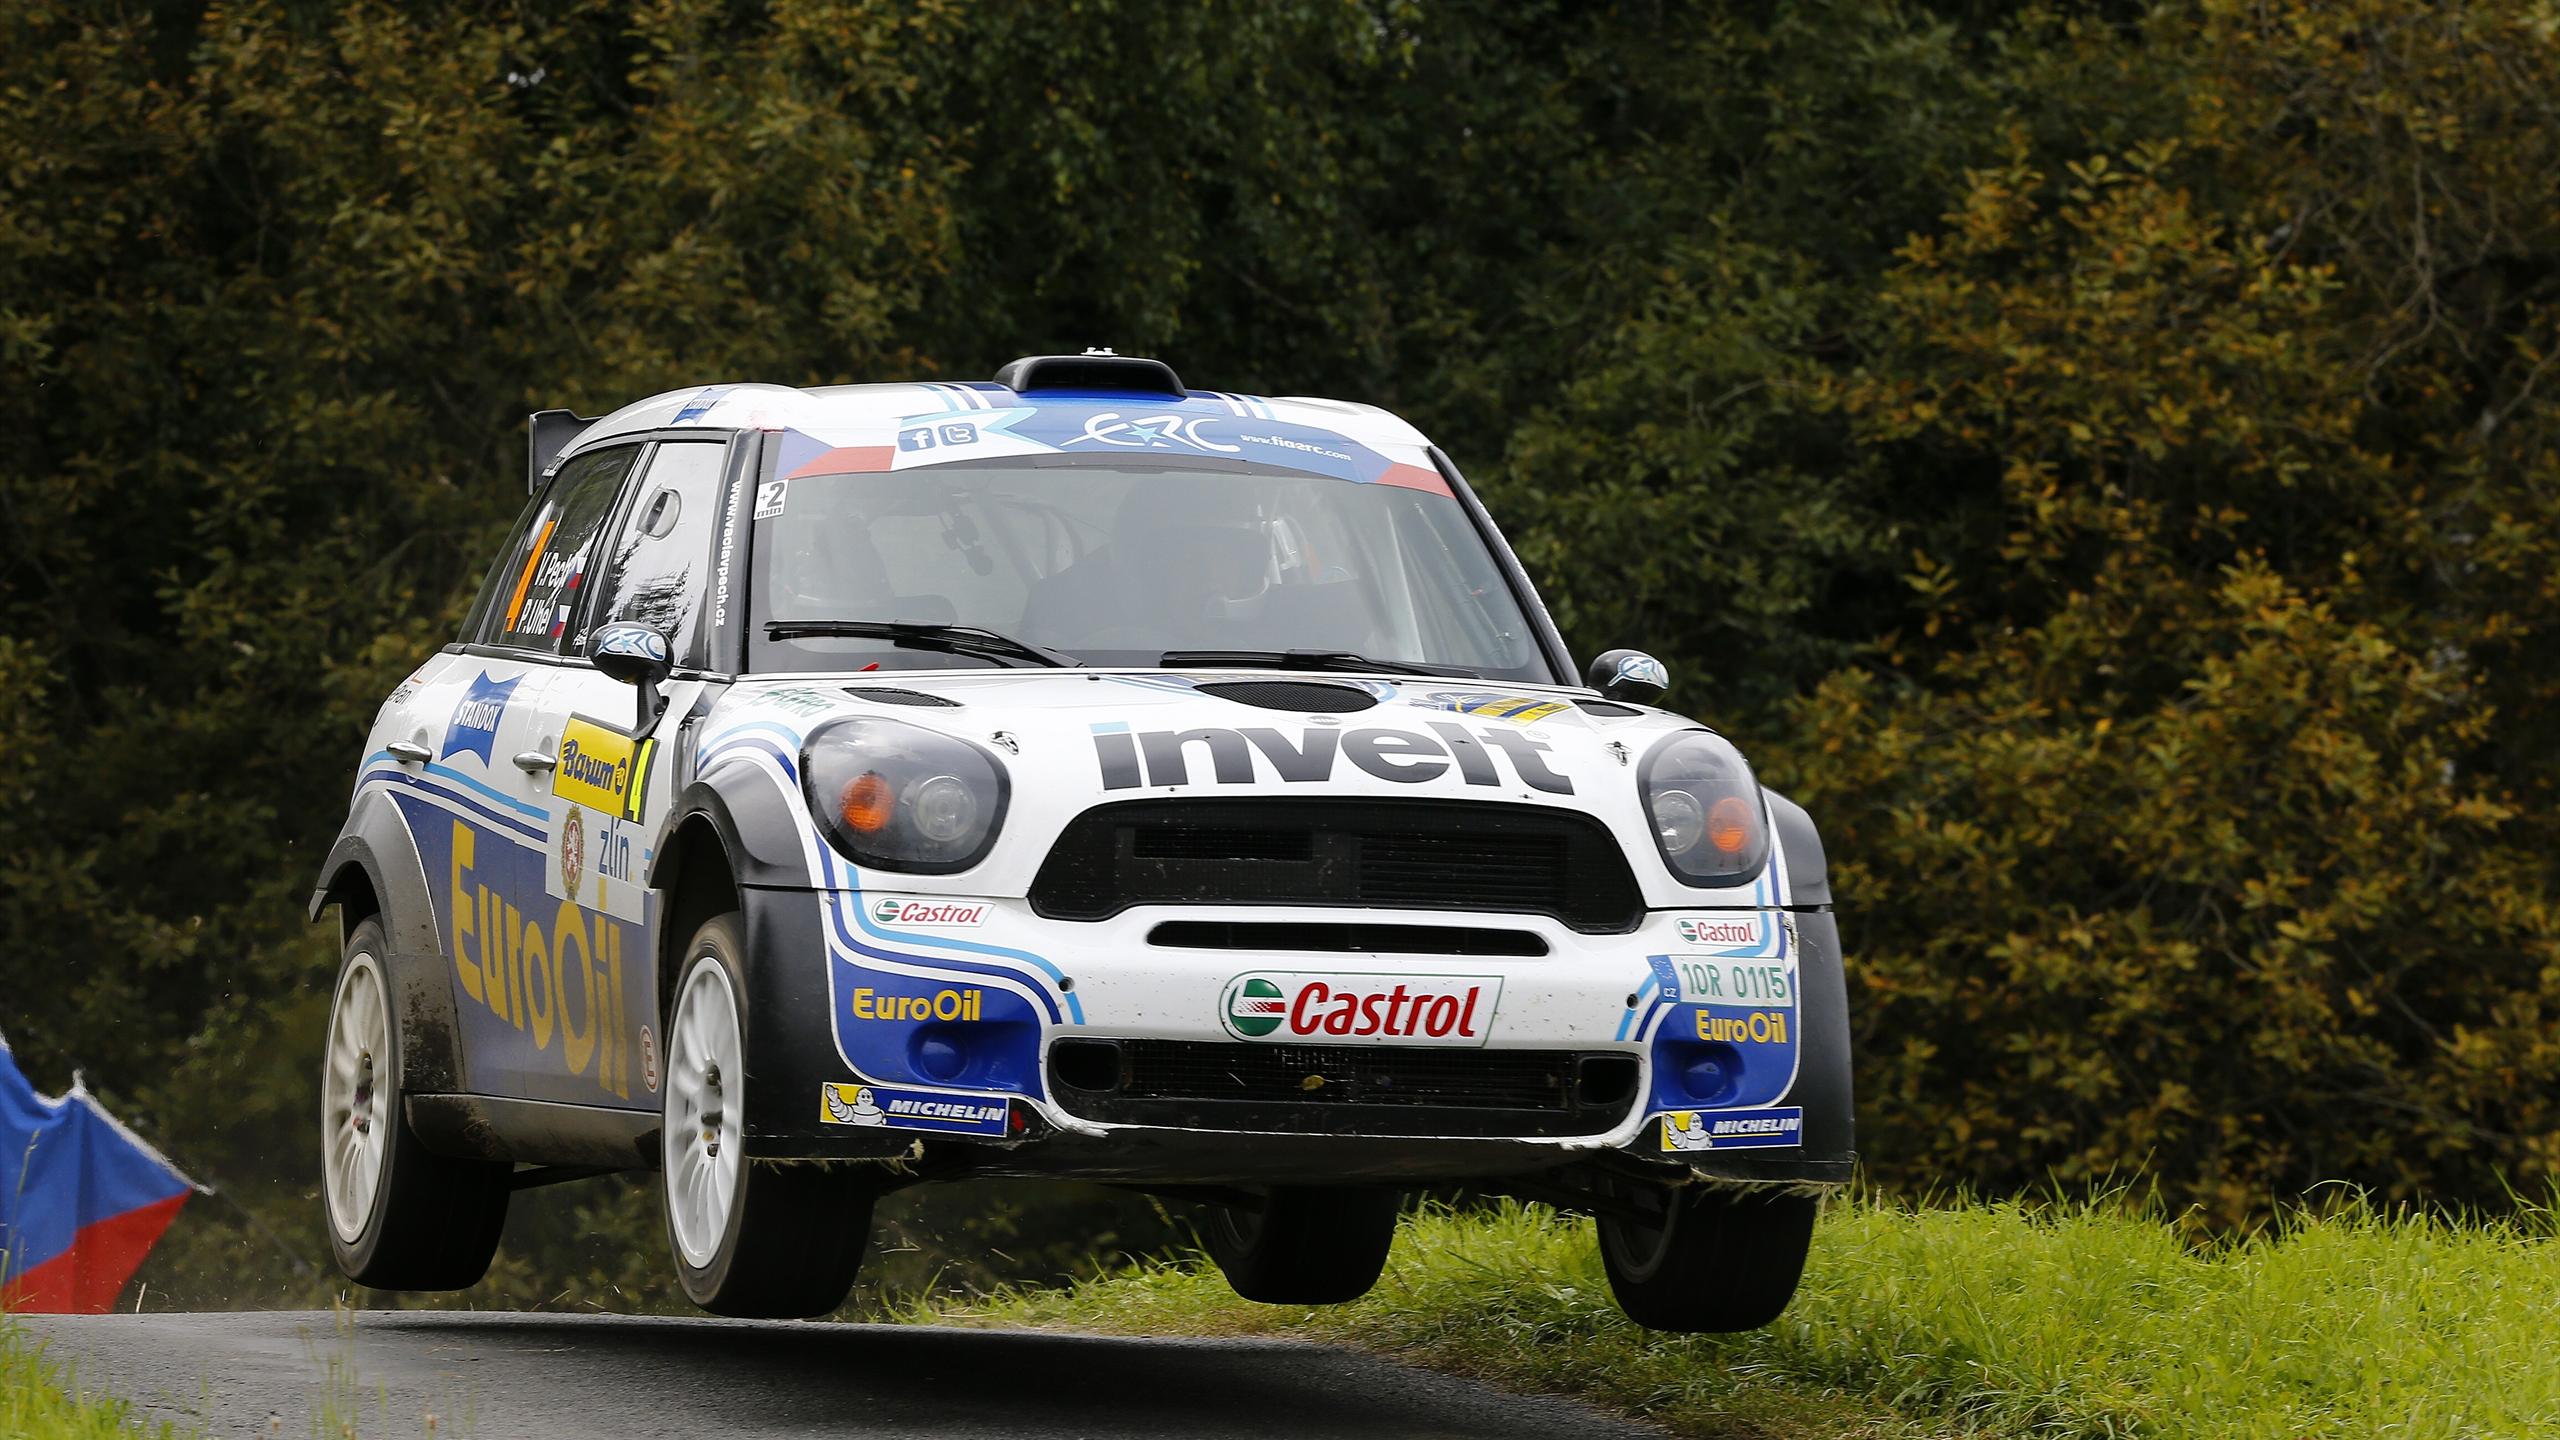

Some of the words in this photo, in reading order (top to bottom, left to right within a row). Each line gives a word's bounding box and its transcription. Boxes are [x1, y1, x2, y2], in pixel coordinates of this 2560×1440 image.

[756, 506, 782, 518] min
[715, 480, 742, 627] www.vaclavpech.cz
[454, 700, 501, 732] STANDOX
[563, 739, 615, 791] Barum
[1090, 720, 1576, 796] invelt
[900, 903, 984, 924] Castrol
[1697, 921, 1755, 943] Castrol
[450, 818, 629, 1100] EuroOil
[853, 988, 983, 1022] EuroOil
[1289, 980, 1482, 1038] Castrol
[1663, 987, 1678, 998] CZ
[1695, 1009, 1788, 1044] EuroOil
[888, 1099, 1006, 1121] MICHELIN
[1711, 1116, 1801, 1135] MICHELIN
